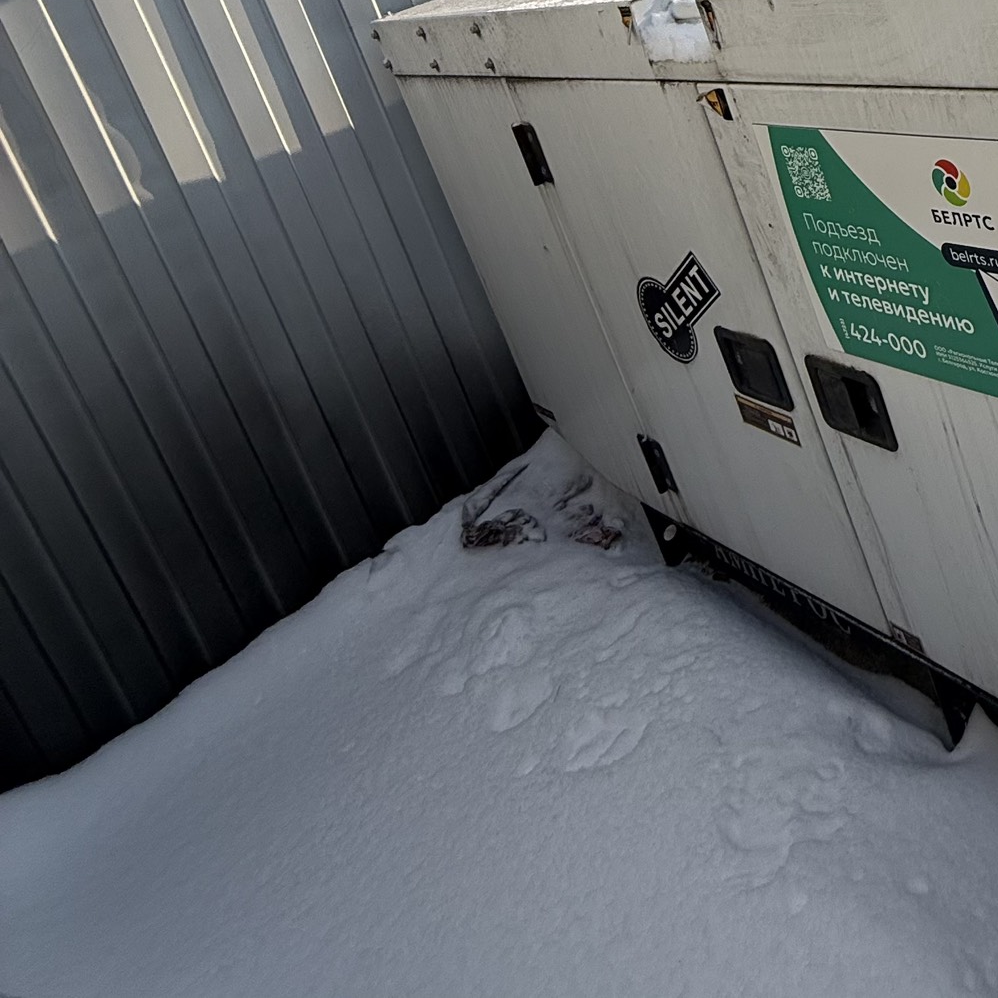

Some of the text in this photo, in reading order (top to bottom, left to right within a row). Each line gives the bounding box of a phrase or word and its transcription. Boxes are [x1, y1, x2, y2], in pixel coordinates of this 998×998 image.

[803, 212, 881, 246] Подъезд
[931, 208, 995, 231] БЕЛРТС
[812, 241, 909, 272] подключен
[654, 264, 710, 339] SILENT
[820, 264, 929, 305] к интернету
[827, 287, 975, 335] и телевидению
[850, 322, 927, 359] 424-000
